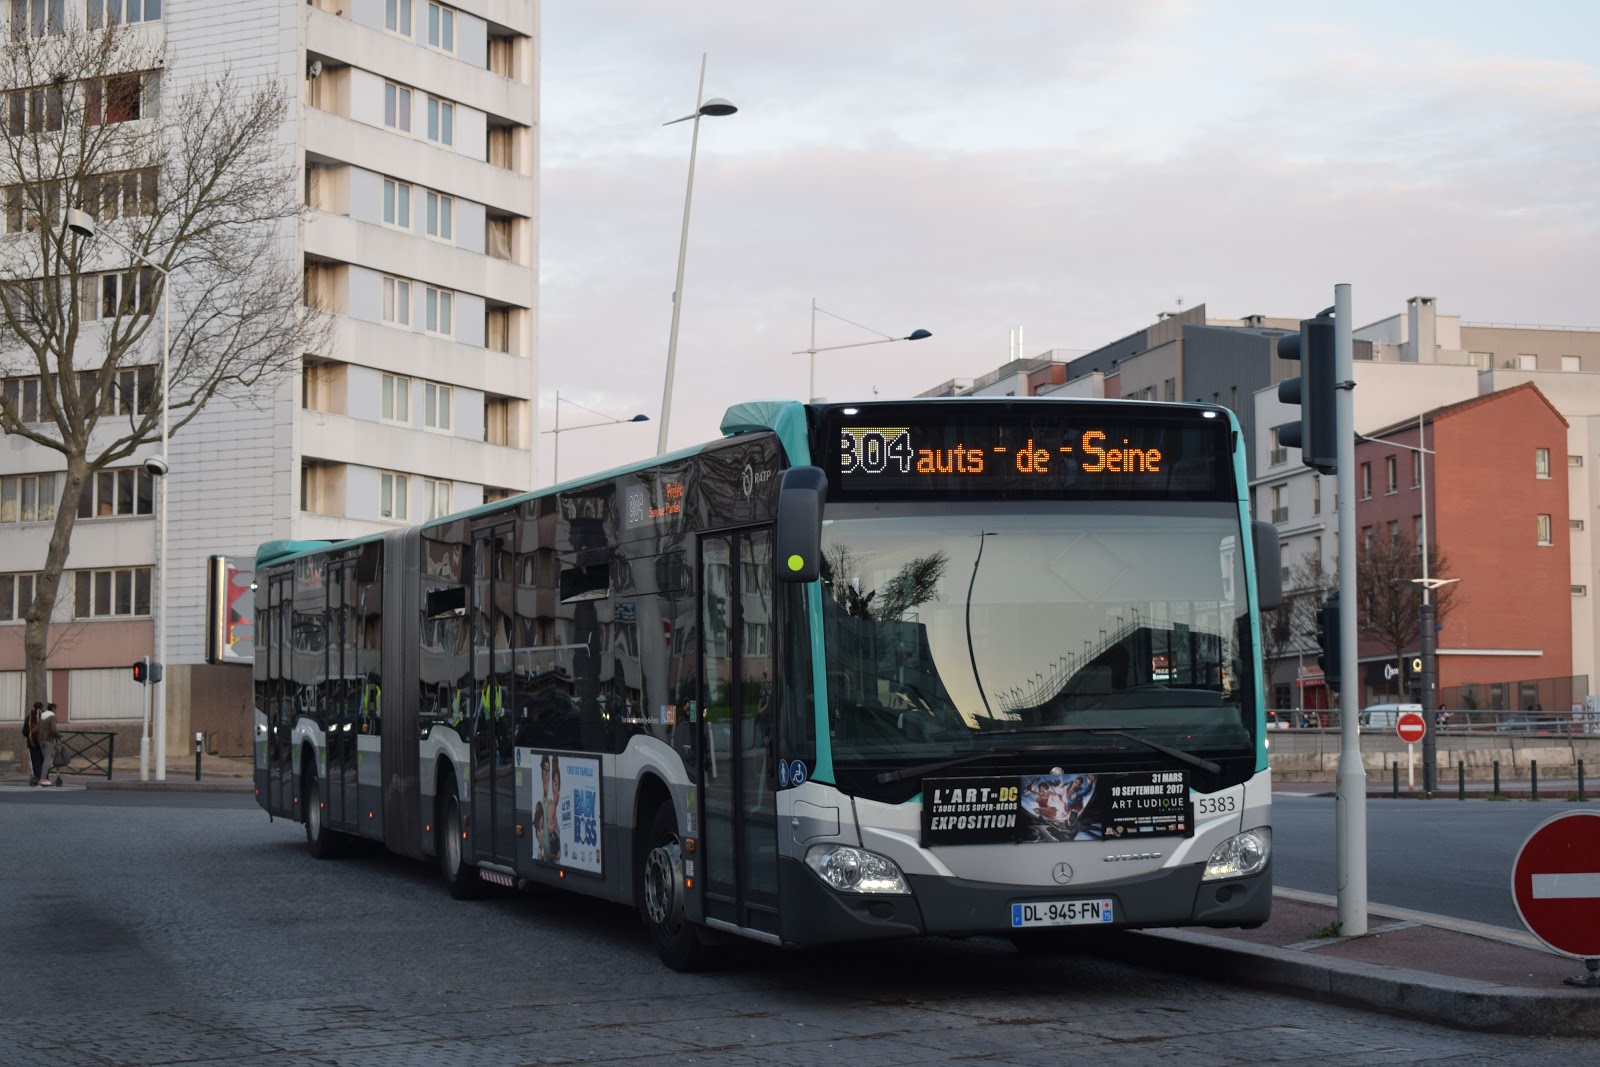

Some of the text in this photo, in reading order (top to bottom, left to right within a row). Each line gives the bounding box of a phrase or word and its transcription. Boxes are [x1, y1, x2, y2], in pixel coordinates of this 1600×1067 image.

[841, 429, 914, 474] 304
[1016, 439, 1050, 473] de
[1082, 430, 1162, 473] Seine
[754, 471, 772, 484] RATP
[1152, 773, 1183, 784] 31 MARS
[933, 788, 991, 804] L'ART
[999, 786, 1018, 802] DC
[1111, 784, 1184, 797] 10 SEPTEMBRE 2017
[574, 789, 596, 818] BABY
[933, 804, 956, 813] L'AUBE
[957, 803, 970, 812] DES
[1112, 798, 1184, 809] ART LUDIQUE
[1199, 796, 1235, 814] 5383
[562, 811, 571, 822] MARS
[931, 814, 1016, 831] EXPOSITION
[574, 817, 597, 847] BOSS
[1103, 852, 1163, 863] CITARO
